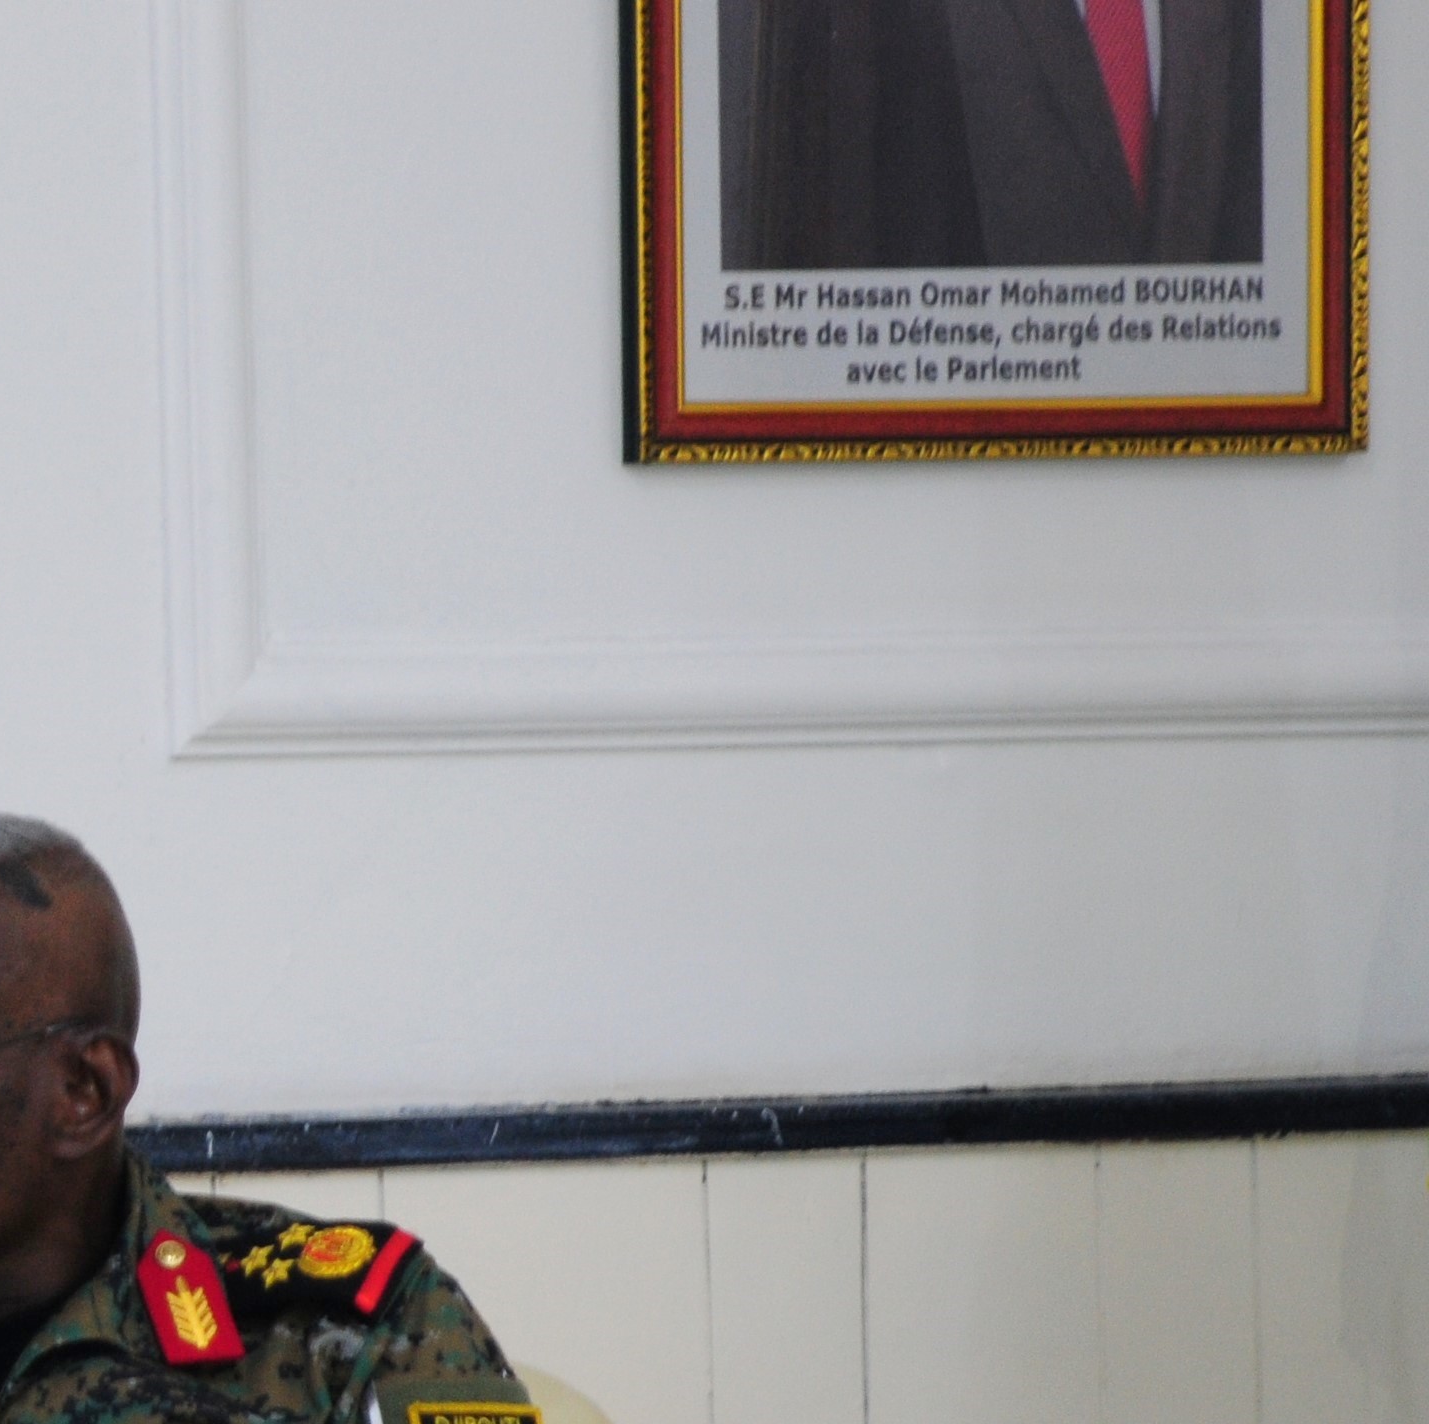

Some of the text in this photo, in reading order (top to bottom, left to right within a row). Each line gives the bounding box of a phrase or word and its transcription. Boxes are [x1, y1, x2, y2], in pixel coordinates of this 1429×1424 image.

[724, 275, 1264, 310] S.E Mr Hassan Omar Mohamed BOURHAN
[701, 312, 1281, 348] Ministre de la Défense, chargé des Relations
[846, 354, 1082, 384] avec le Parlement
